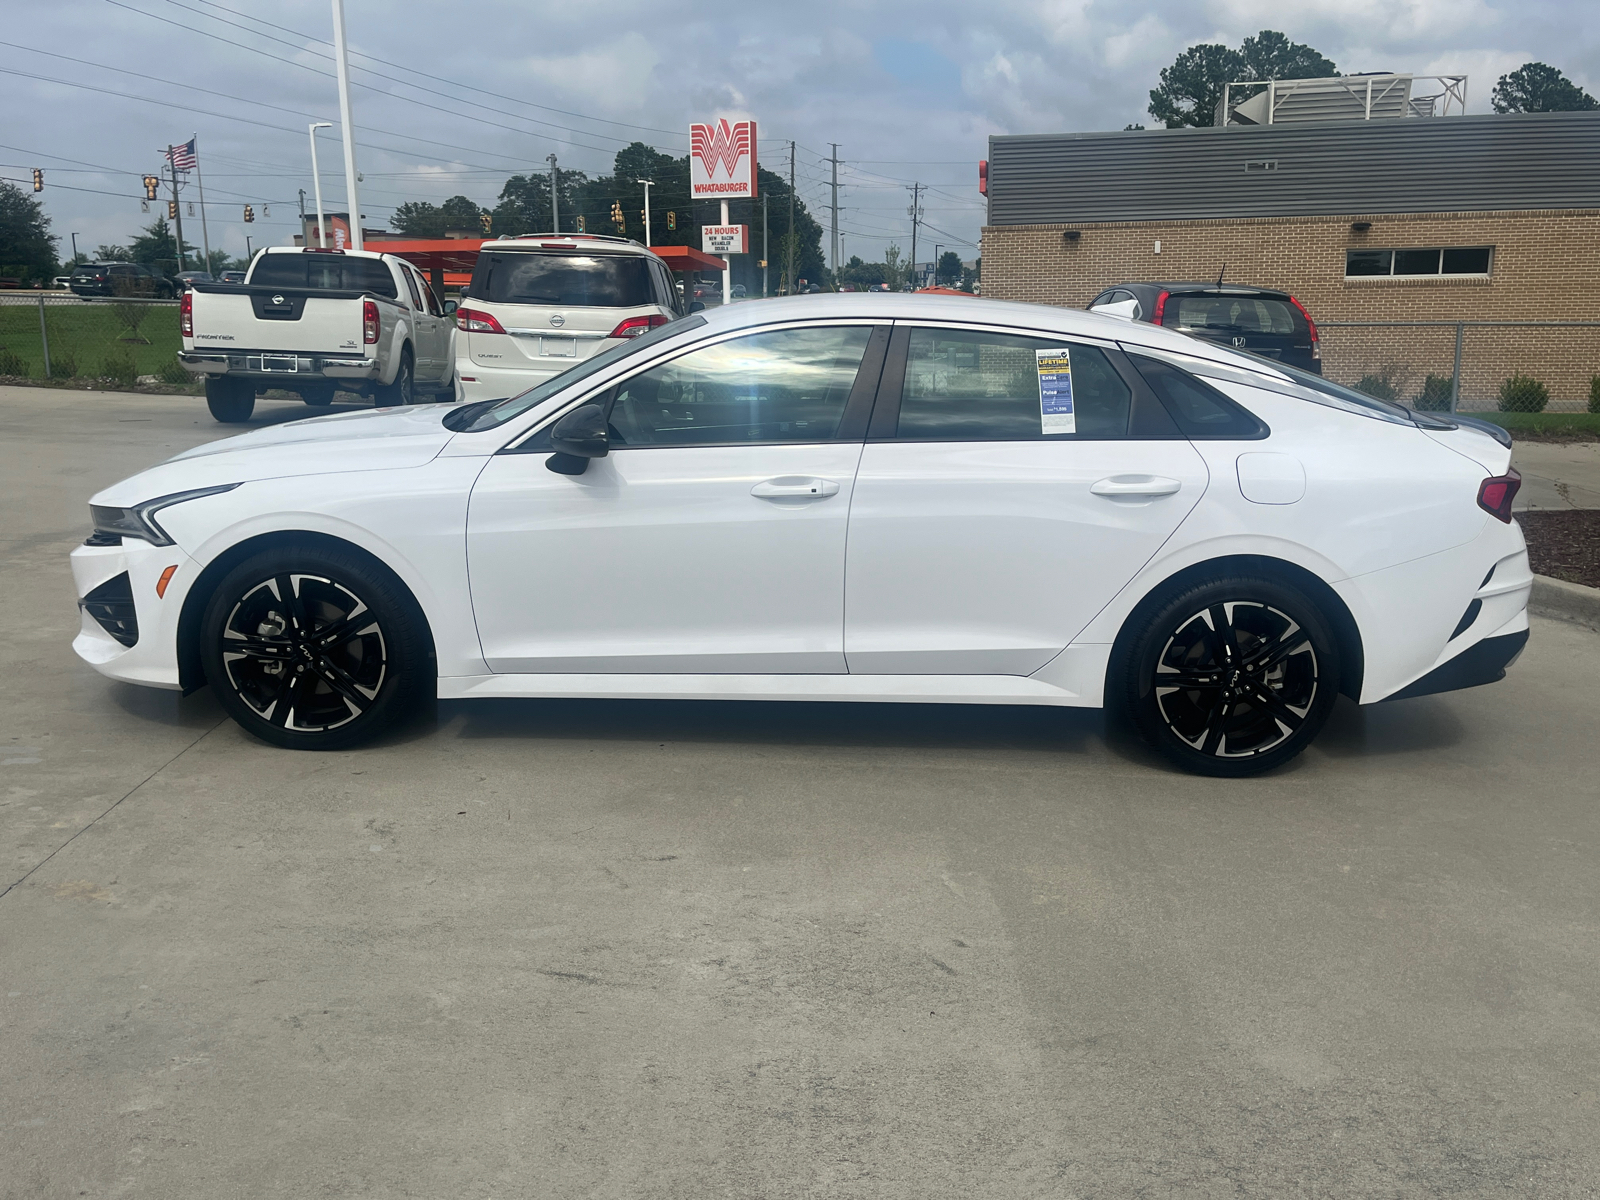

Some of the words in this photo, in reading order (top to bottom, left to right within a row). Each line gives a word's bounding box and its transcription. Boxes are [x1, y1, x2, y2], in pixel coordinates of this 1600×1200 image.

[694, 182, 748, 194] WHATABURGER
[704, 227, 713, 235] 24
[714, 226, 739, 235] HOURS
